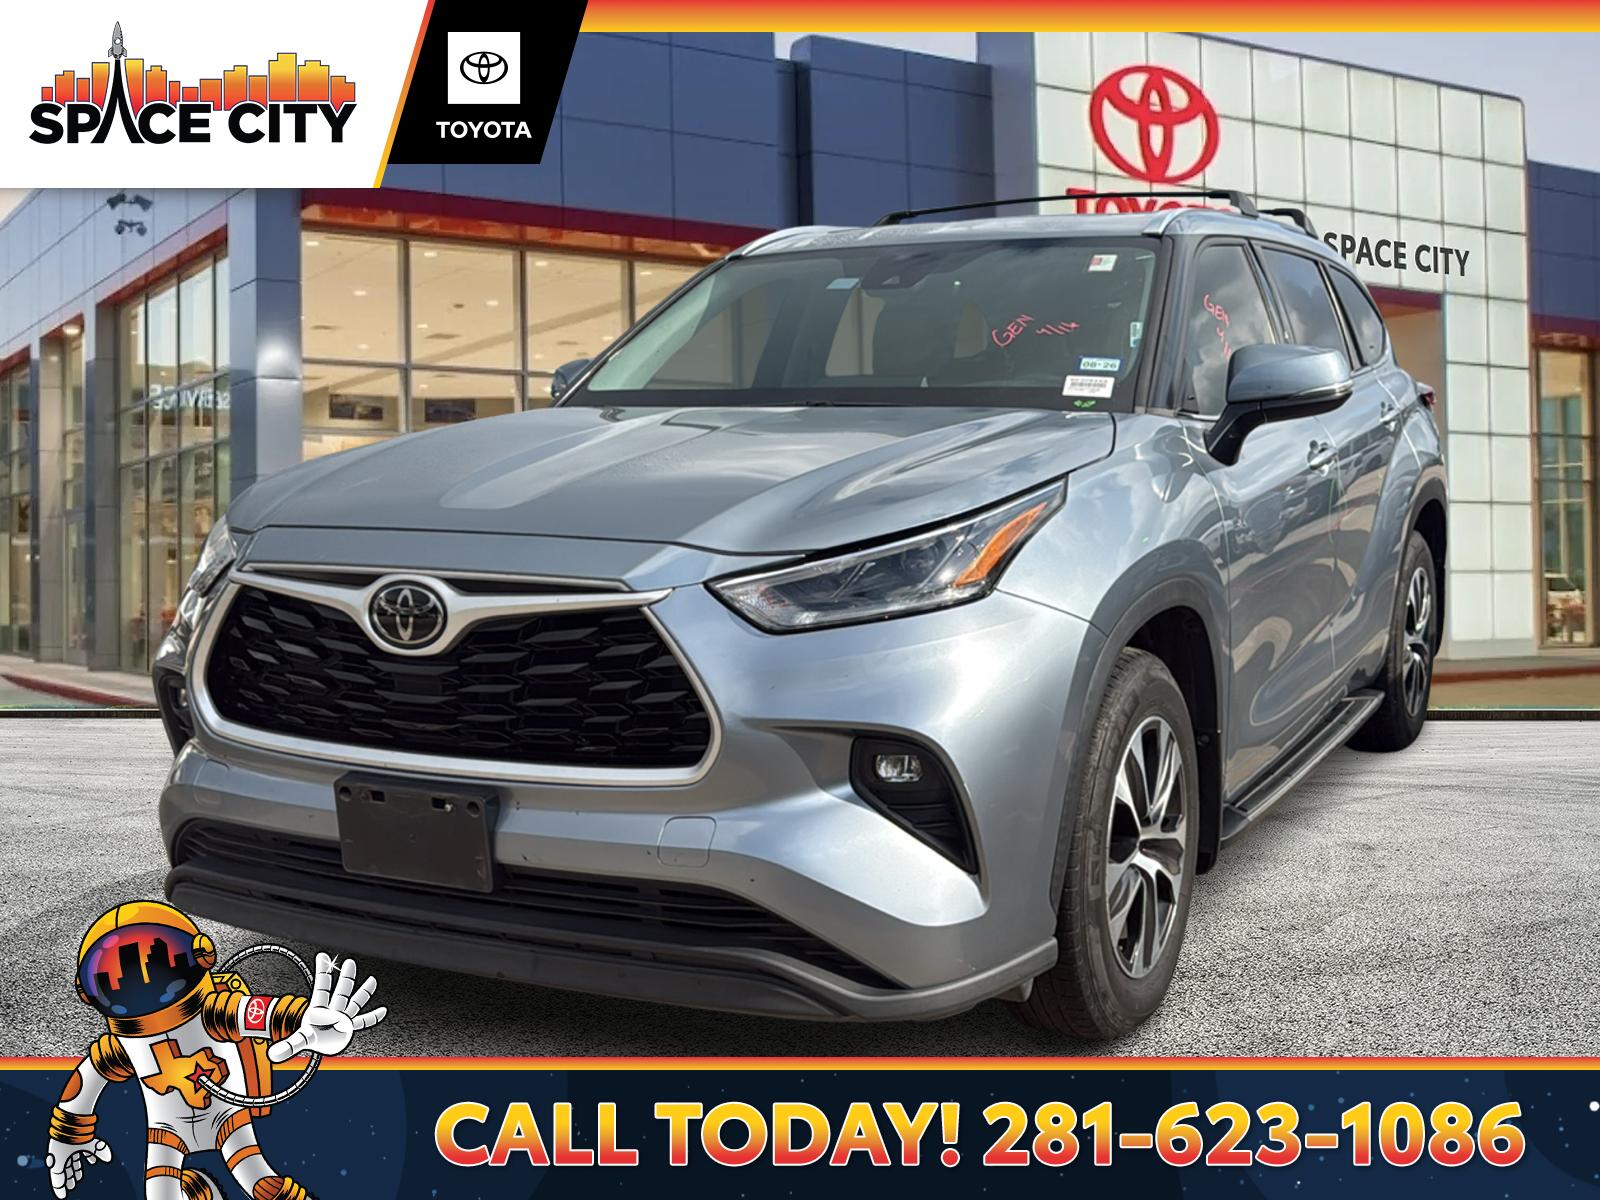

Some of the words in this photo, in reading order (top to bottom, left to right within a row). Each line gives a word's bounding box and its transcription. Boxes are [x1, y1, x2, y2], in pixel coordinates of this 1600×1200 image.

[1323, 231, 1407, 270] SPACE
[1414, 244, 1470, 277] CITY
[992, 313, 1035, 347] GEN
